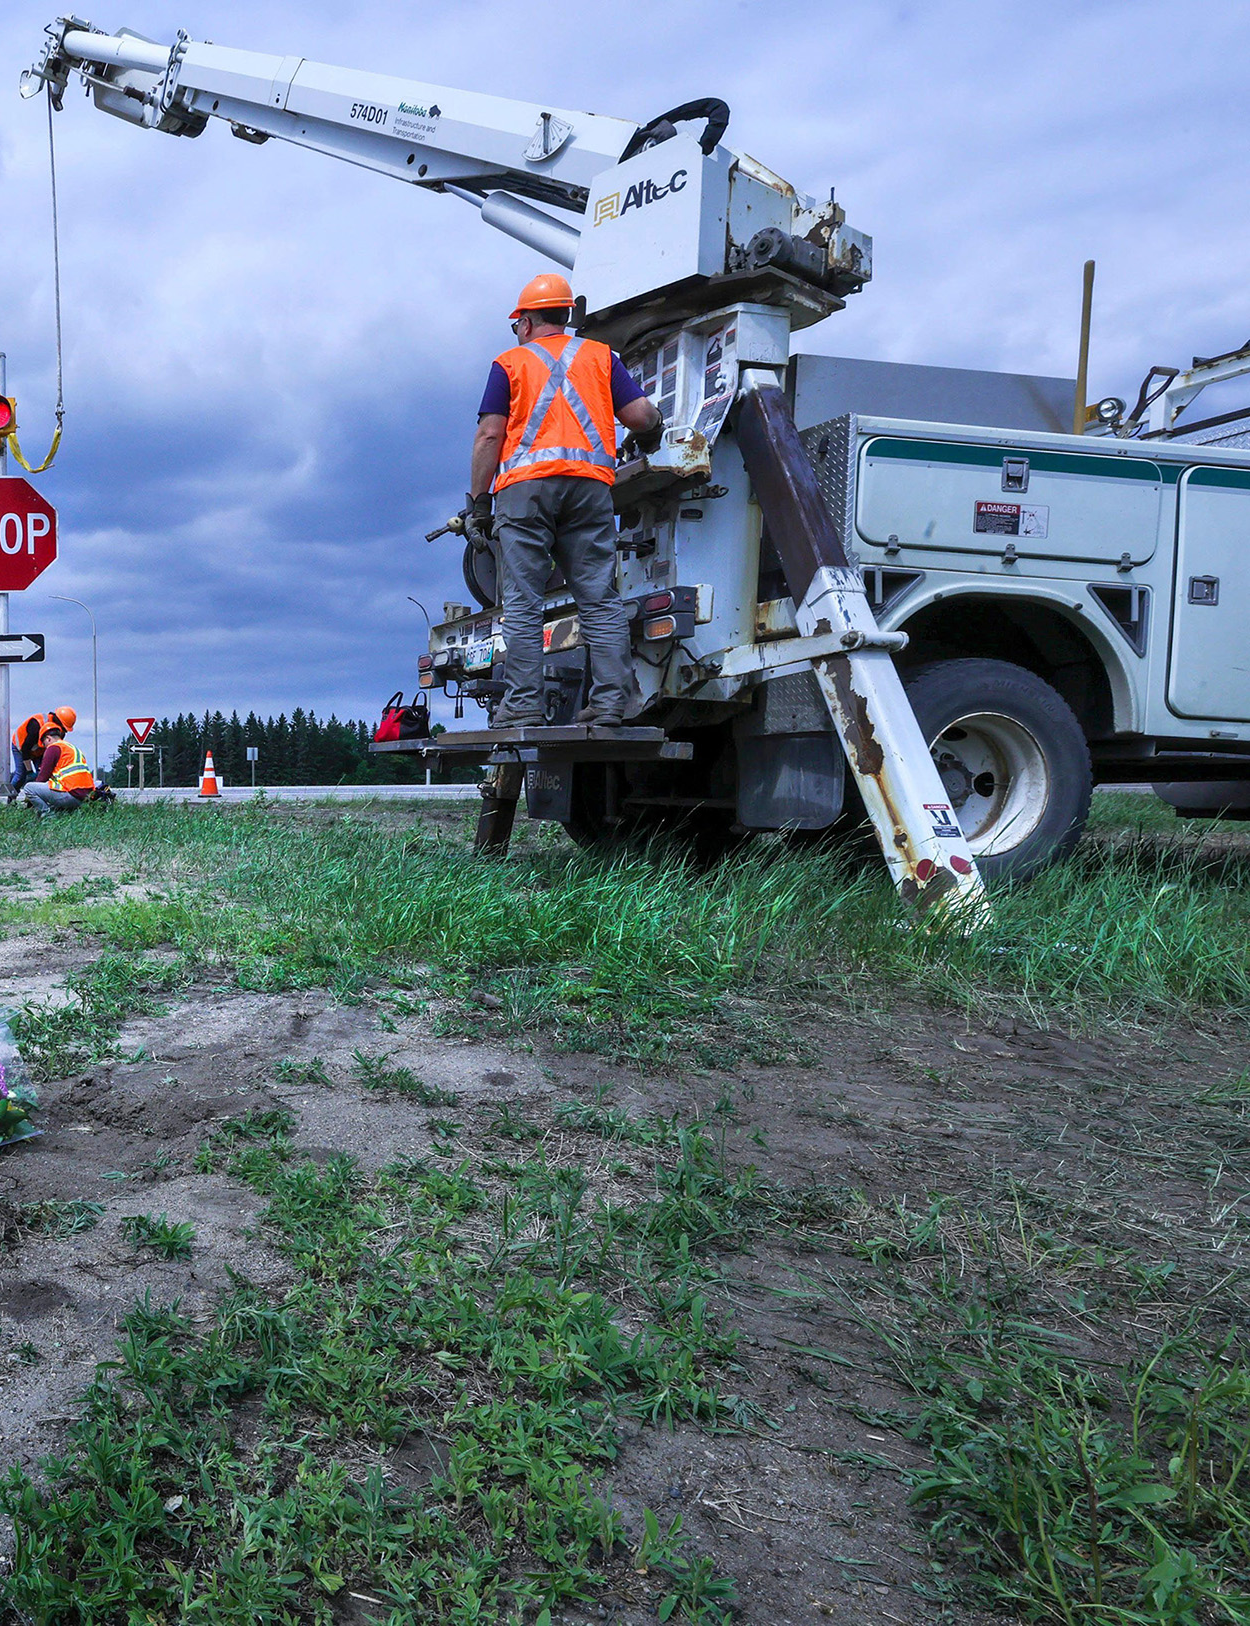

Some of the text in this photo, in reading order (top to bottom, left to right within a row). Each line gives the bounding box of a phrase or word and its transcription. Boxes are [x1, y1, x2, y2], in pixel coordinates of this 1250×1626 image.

[350, 103, 388, 125] 574D01
[398, 102, 428, 117] Manitoba
[395, 117, 436, 133] Infrastructure and
[392, 126, 425, 141] Transportation
[620, 169, 688, 216] Altec
[987, 504, 1017, 513] DANGER
